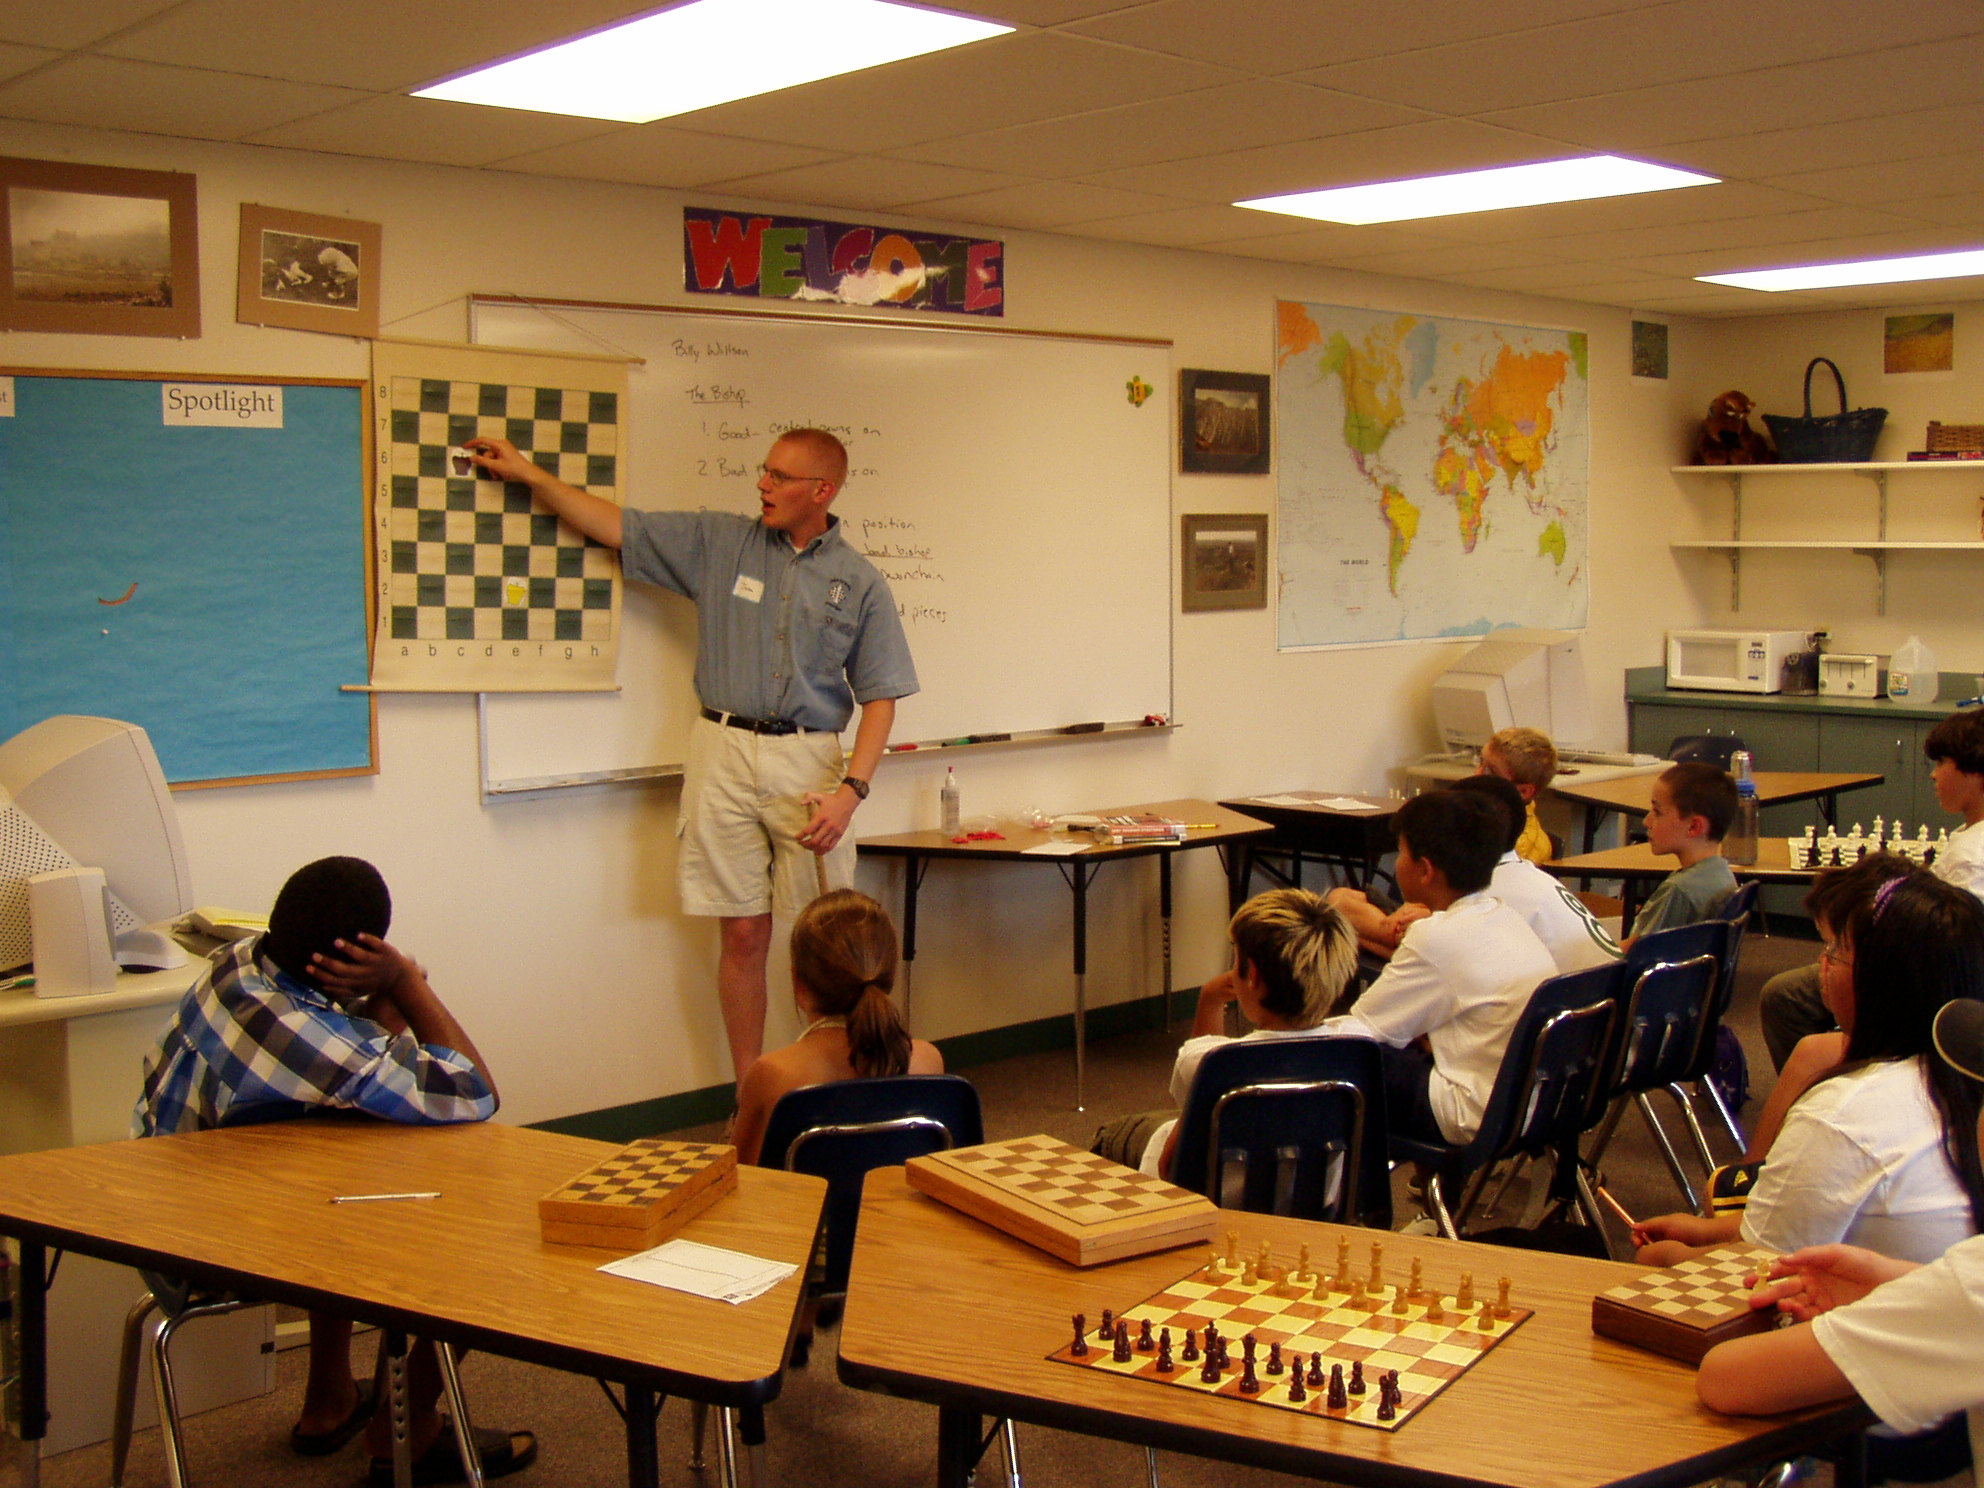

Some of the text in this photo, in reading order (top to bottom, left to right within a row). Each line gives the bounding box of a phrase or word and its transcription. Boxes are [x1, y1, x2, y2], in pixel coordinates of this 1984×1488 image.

[686, 216, 1001, 311] WELCOME
[379, 386, 387, 399] 8
[685, 385, 705, 400] The
[169, 388, 275, 419] Spotlight
[380, 418, 388, 431] 7
[863, 426, 881, 436] on
[380, 452, 389, 465] 6
[716, 458, 749, 478] Bad
[381, 485, 389, 498] 5
[381, 517, 388, 530] 4
[862, 518, 916, 538] position
[382, 550, 389, 563] 3
[382, 583, 389, 596] 2
[382, 616, 388, 628] 1
[911, 604, 948, 627] pieces
[401, 644, 599, 660] a b c d e f g h
